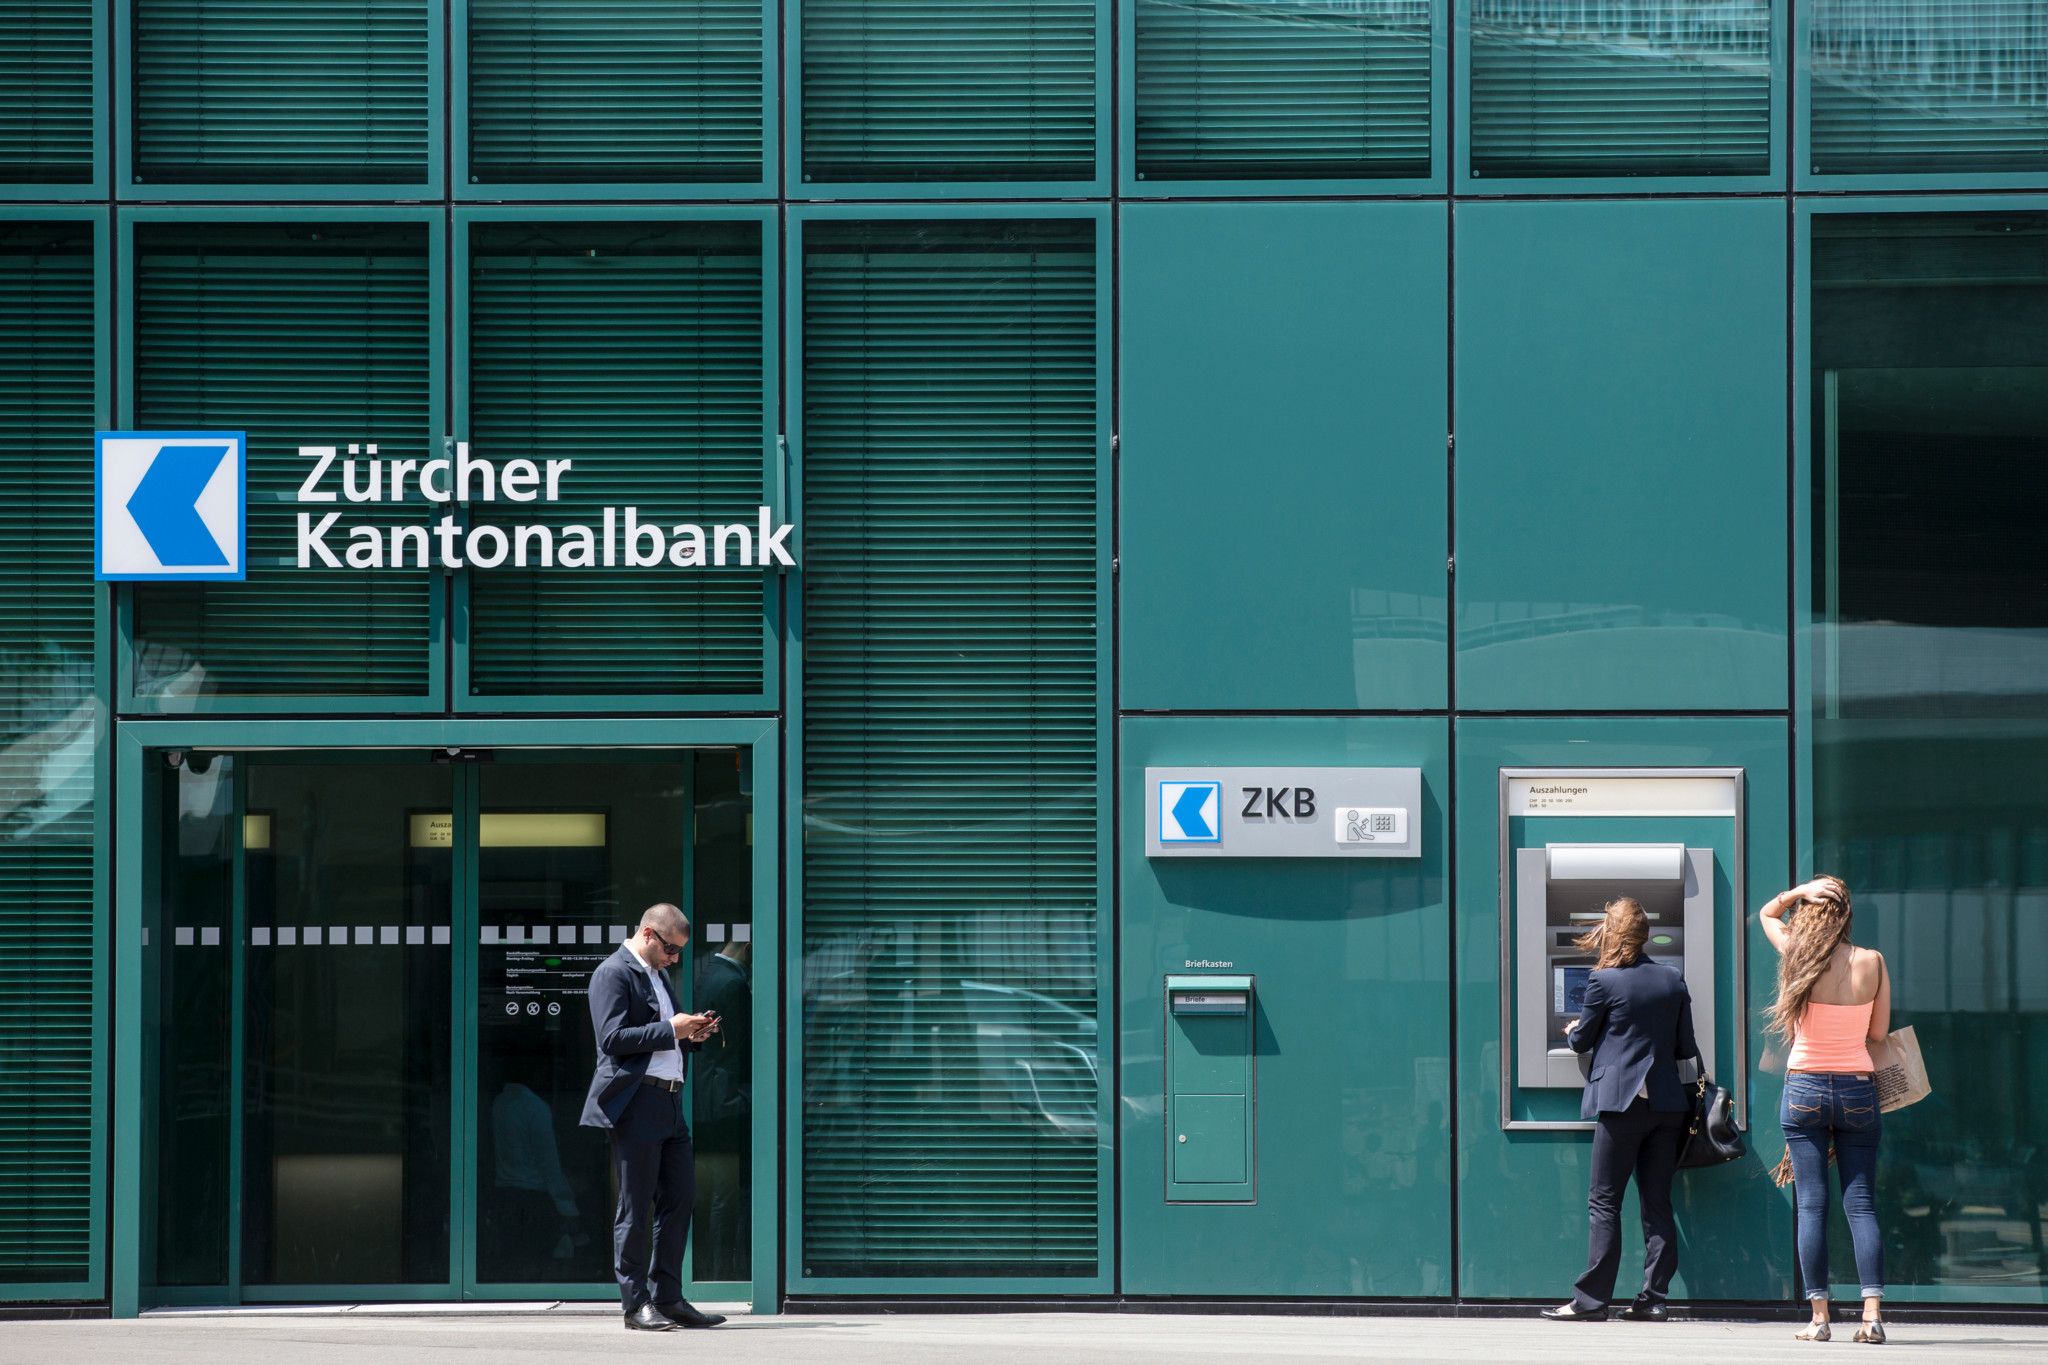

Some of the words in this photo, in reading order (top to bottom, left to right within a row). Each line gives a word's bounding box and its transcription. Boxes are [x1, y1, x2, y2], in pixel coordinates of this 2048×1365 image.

[297, 441, 572, 502] Zürcher
[297, 506, 796, 568] Kantonalbank
[1241, 787, 1315, 818] ZKB
[1529, 786, 1588, 795] Auszahlungen
[1185, 959, 1233, 968] Briefkasten
